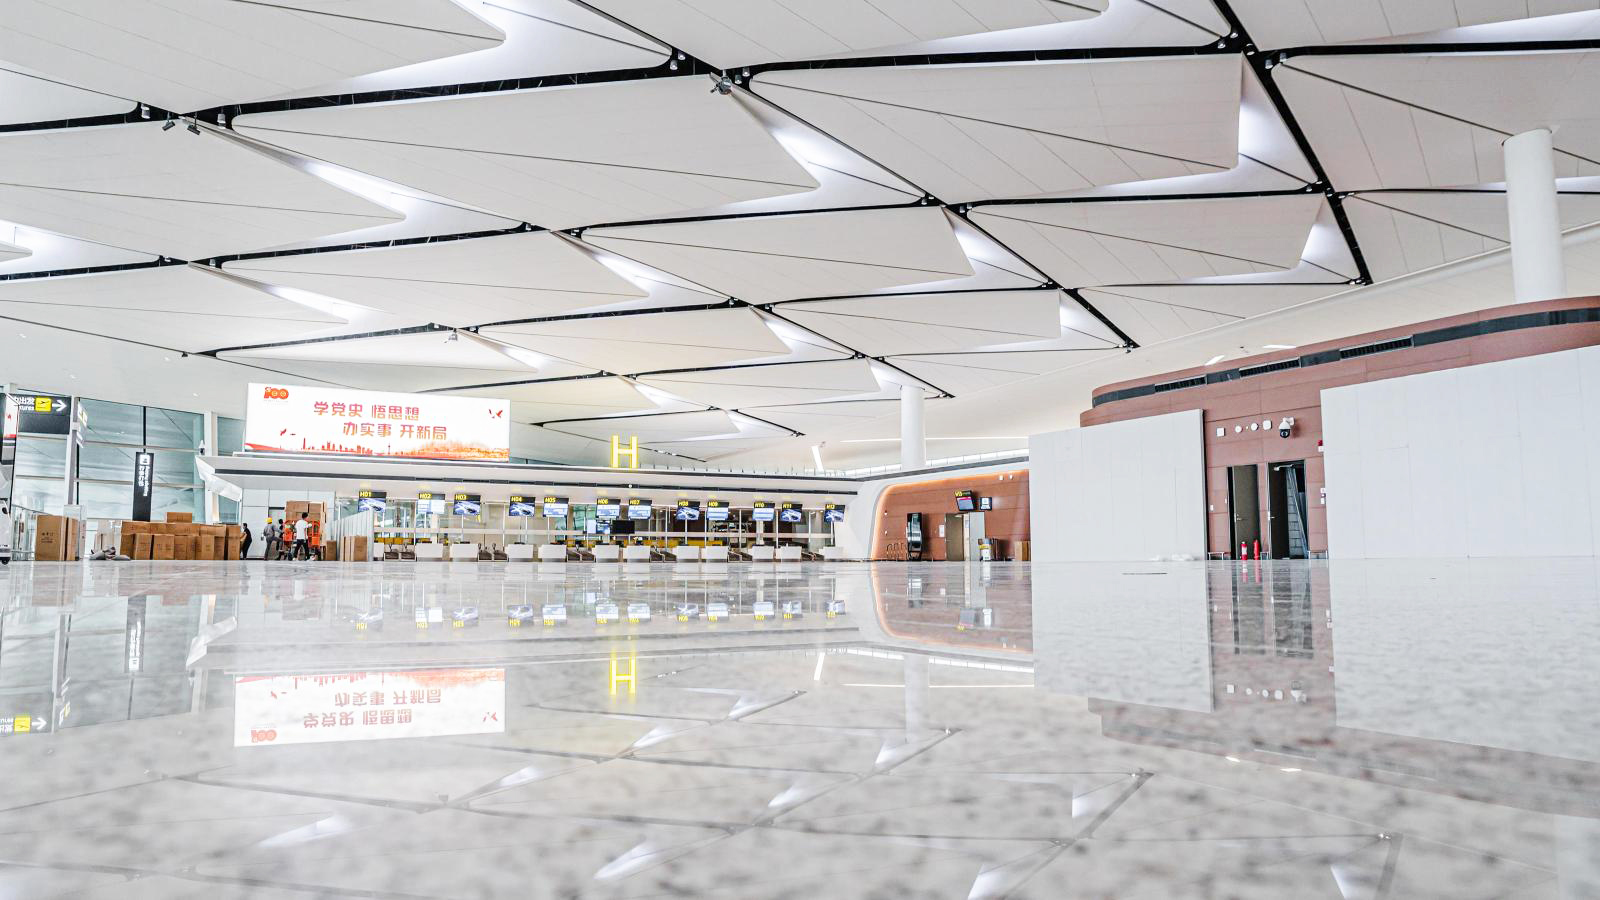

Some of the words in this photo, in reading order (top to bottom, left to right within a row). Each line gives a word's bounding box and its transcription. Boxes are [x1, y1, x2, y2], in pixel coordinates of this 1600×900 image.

[313, 401, 363, 418] 学党史
[371, 404, 420, 421] 悟思想
[343, 421, 392, 438] 办实事
[400, 424, 447, 441] 开新局
[611, 435, 638, 468] H
